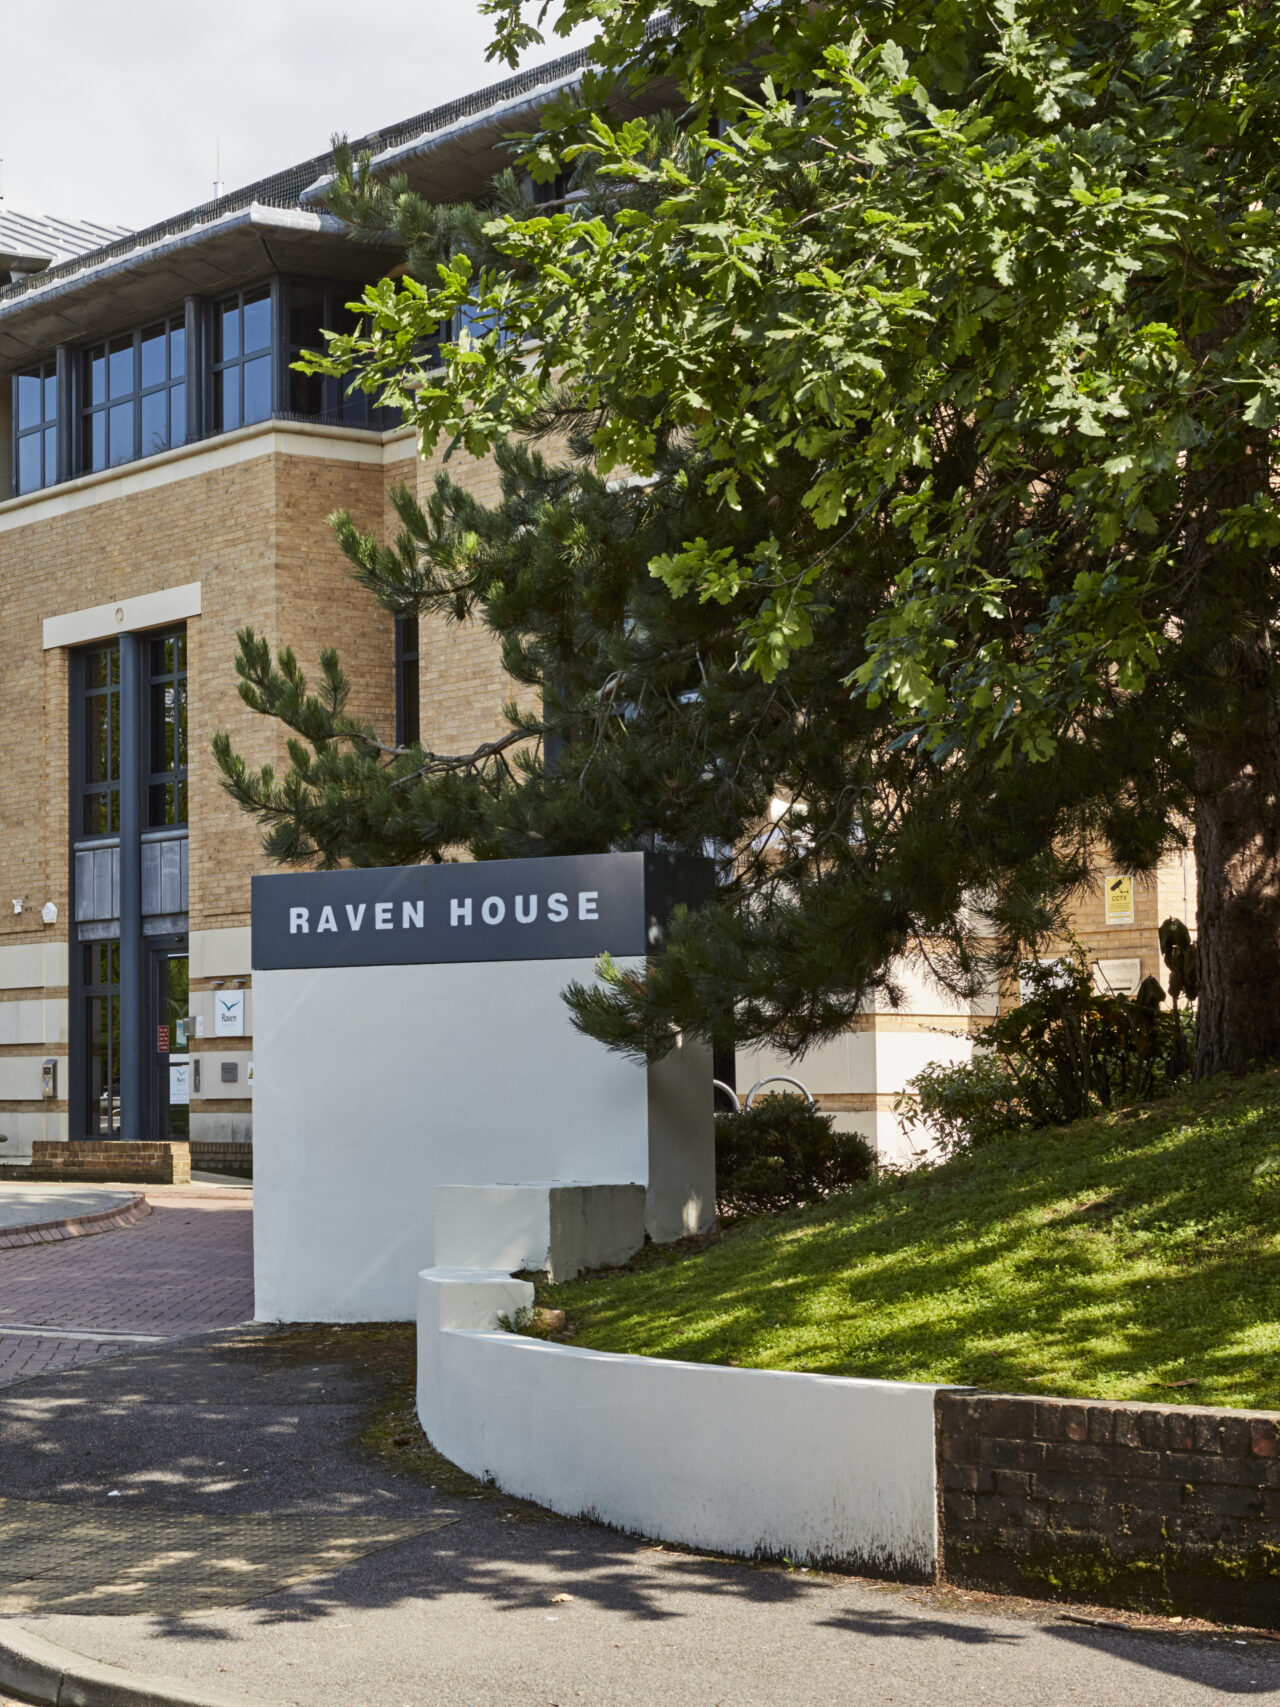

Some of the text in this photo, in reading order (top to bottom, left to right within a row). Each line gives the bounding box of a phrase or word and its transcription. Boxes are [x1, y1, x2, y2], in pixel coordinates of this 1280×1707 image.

[289, 891, 600, 934] RAVEN HOUSE
[221, 1013, 237, 1023] Raven
